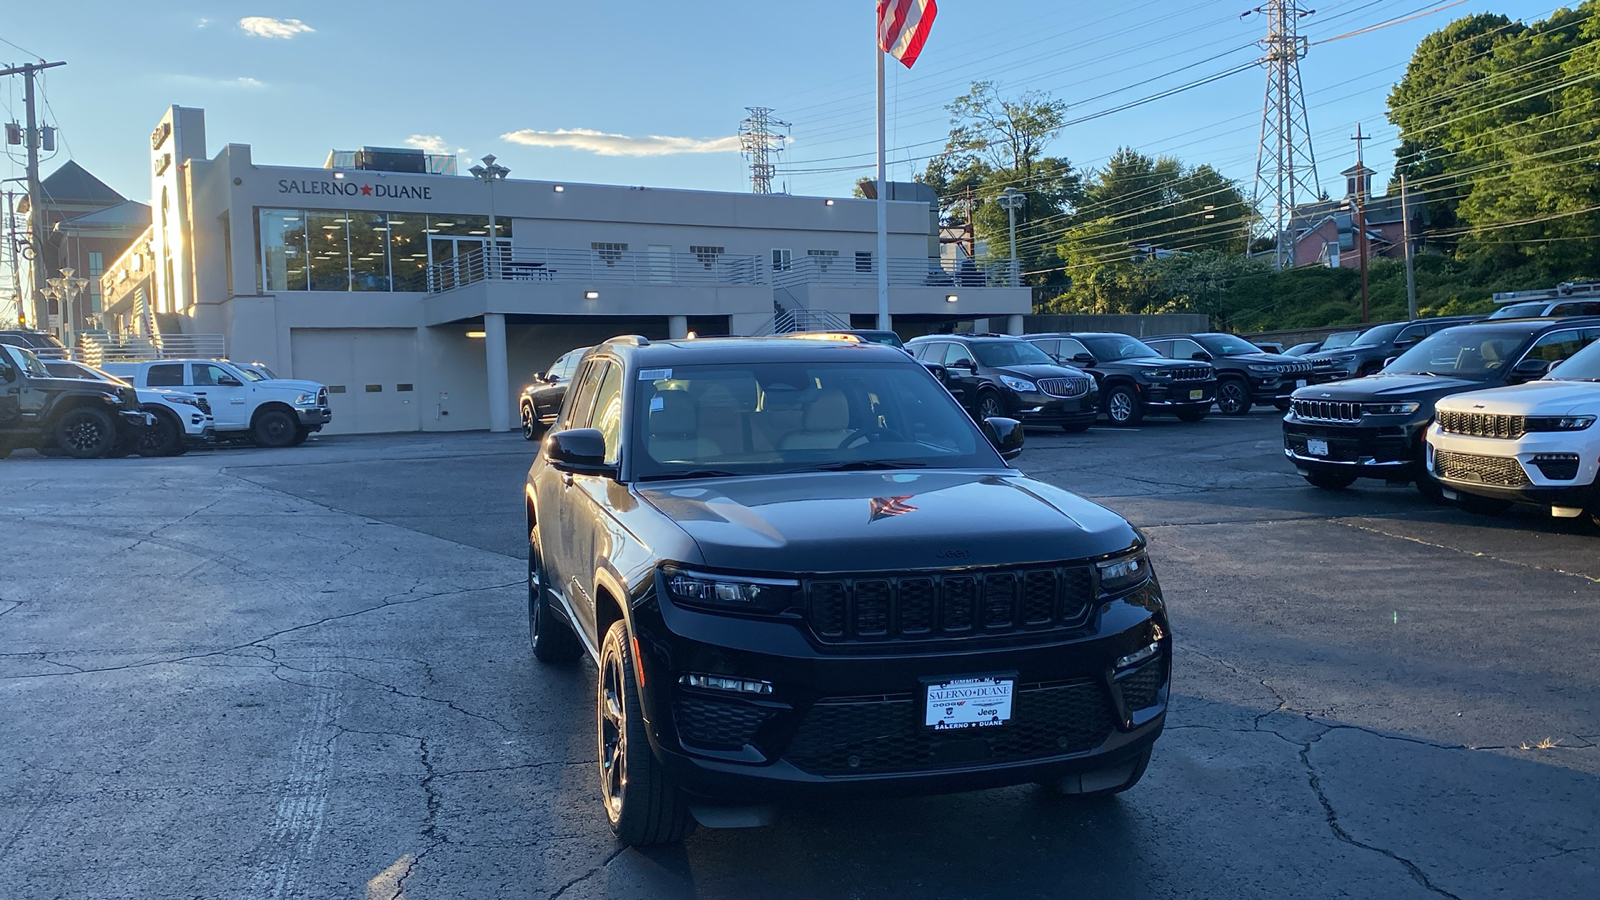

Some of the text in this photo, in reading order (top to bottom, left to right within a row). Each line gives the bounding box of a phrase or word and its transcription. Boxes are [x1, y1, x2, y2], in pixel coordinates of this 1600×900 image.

[278, 179, 432, 200] SALERNO DUANE
[936, 548, 971, 560] Jeep
[929, 686, 1010, 700] SALERNO DUANE
[977, 708, 998, 716] Jeep
[934, 722, 969, 730] SALERNO
